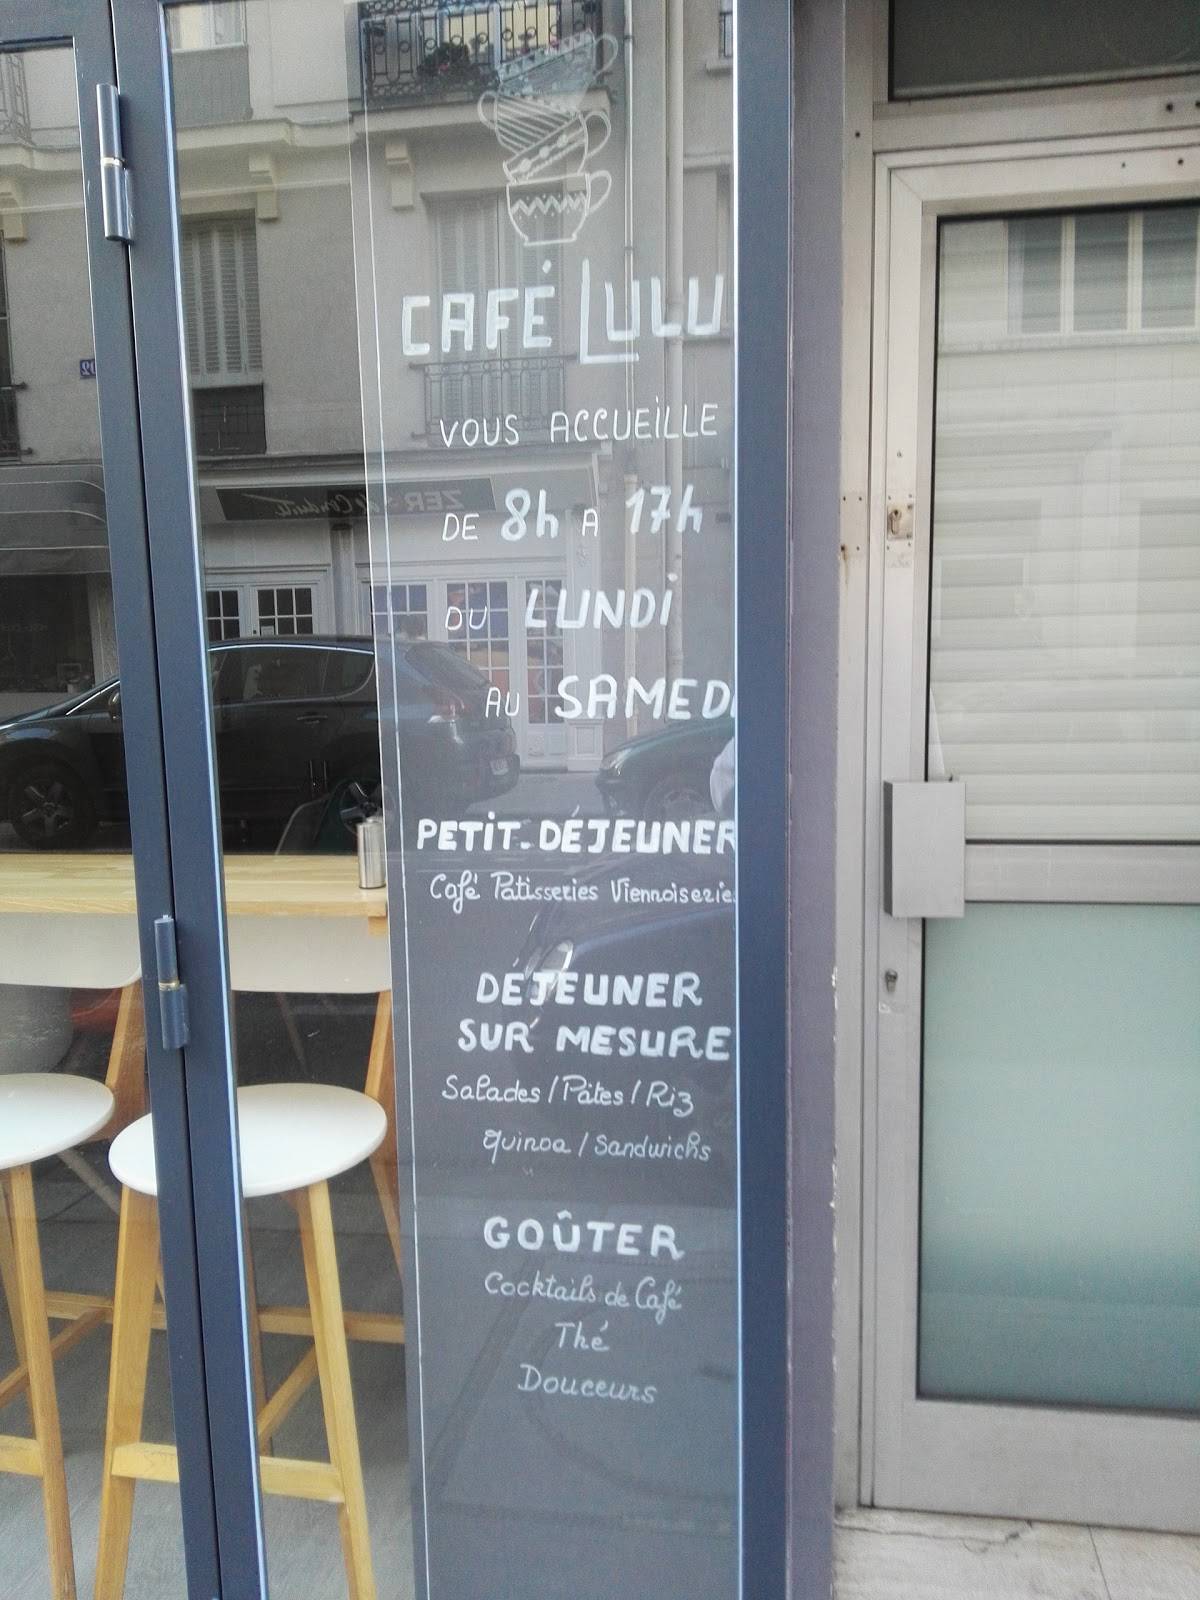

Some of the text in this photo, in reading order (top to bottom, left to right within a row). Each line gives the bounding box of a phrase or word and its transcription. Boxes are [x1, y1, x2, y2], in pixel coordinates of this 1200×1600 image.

[402, 259, 555, 355] CAFÉ
[440, 396, 718, 447] VOUS ACCUEILLE
[442, 512, 480, 541] DE
[501, 488, 559, 541] 8h
[625, 484, 702, 534] 17h
[445, 572, 678, 631] DU LUNDI
[485, 687, 520, 718] AU
[430, 870, 480, 914] Café
[610, 877, 736, 904] Viennoiserie
[476, 957, 702, 1008] DÉJEUNER
[458, 1018, 731, 1061] SUR MESURE
[442, 1074, 541, 1103] Salades
[646, 1080, 694, 1118] Riz
[594, 1131, 712, 1161] Sandwichs
[483, 1209, 685, 1261] GOÛTER
[484, 1269, 682, 1325] Cocktails de Café
[554, 1319, 610, 1351] Thé
[517, 1363, 658, 1404] Douceurs
